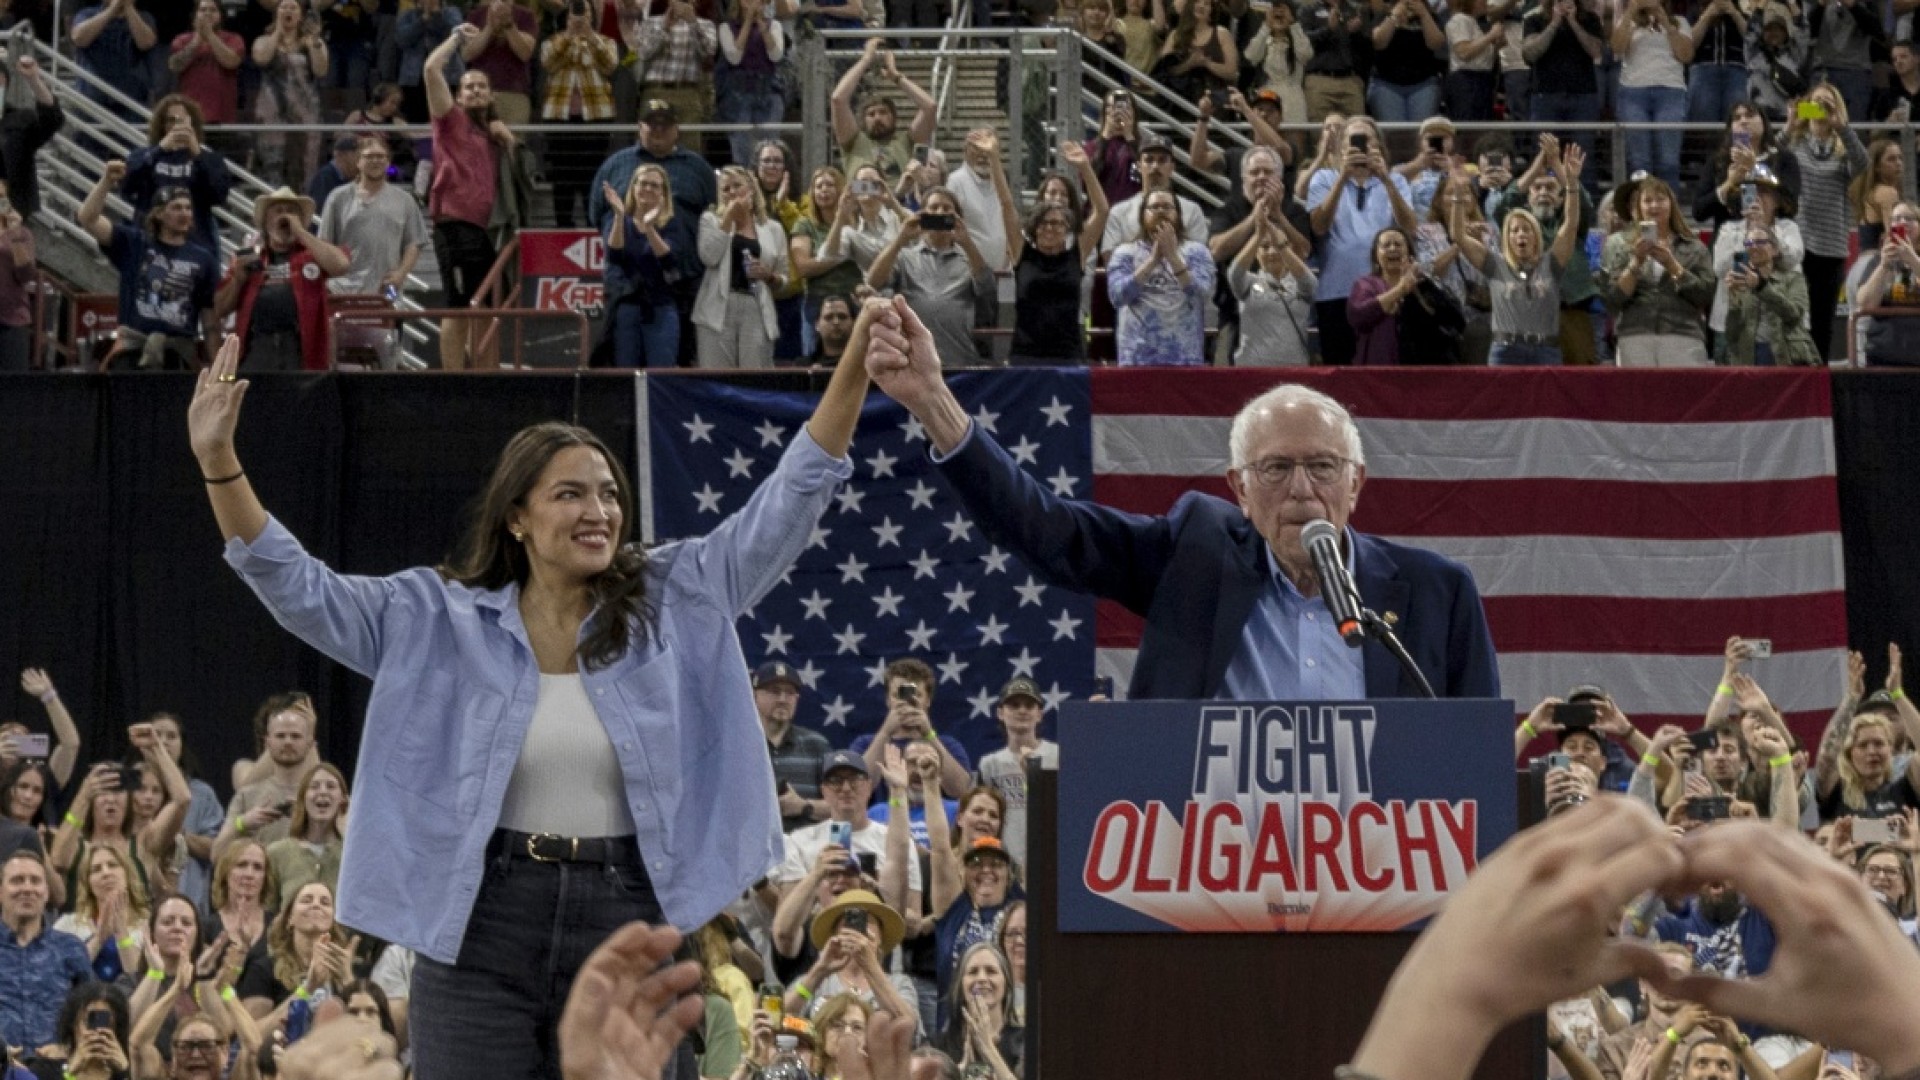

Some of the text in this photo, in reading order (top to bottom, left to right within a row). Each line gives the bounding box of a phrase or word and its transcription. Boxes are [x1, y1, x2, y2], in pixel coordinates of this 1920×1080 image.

[1193, 706, 1377, 796] FIGHT
[1084, 799, 1478, 894] OLIGARCHY
[1267, 902, 1311, 915] Bernie
